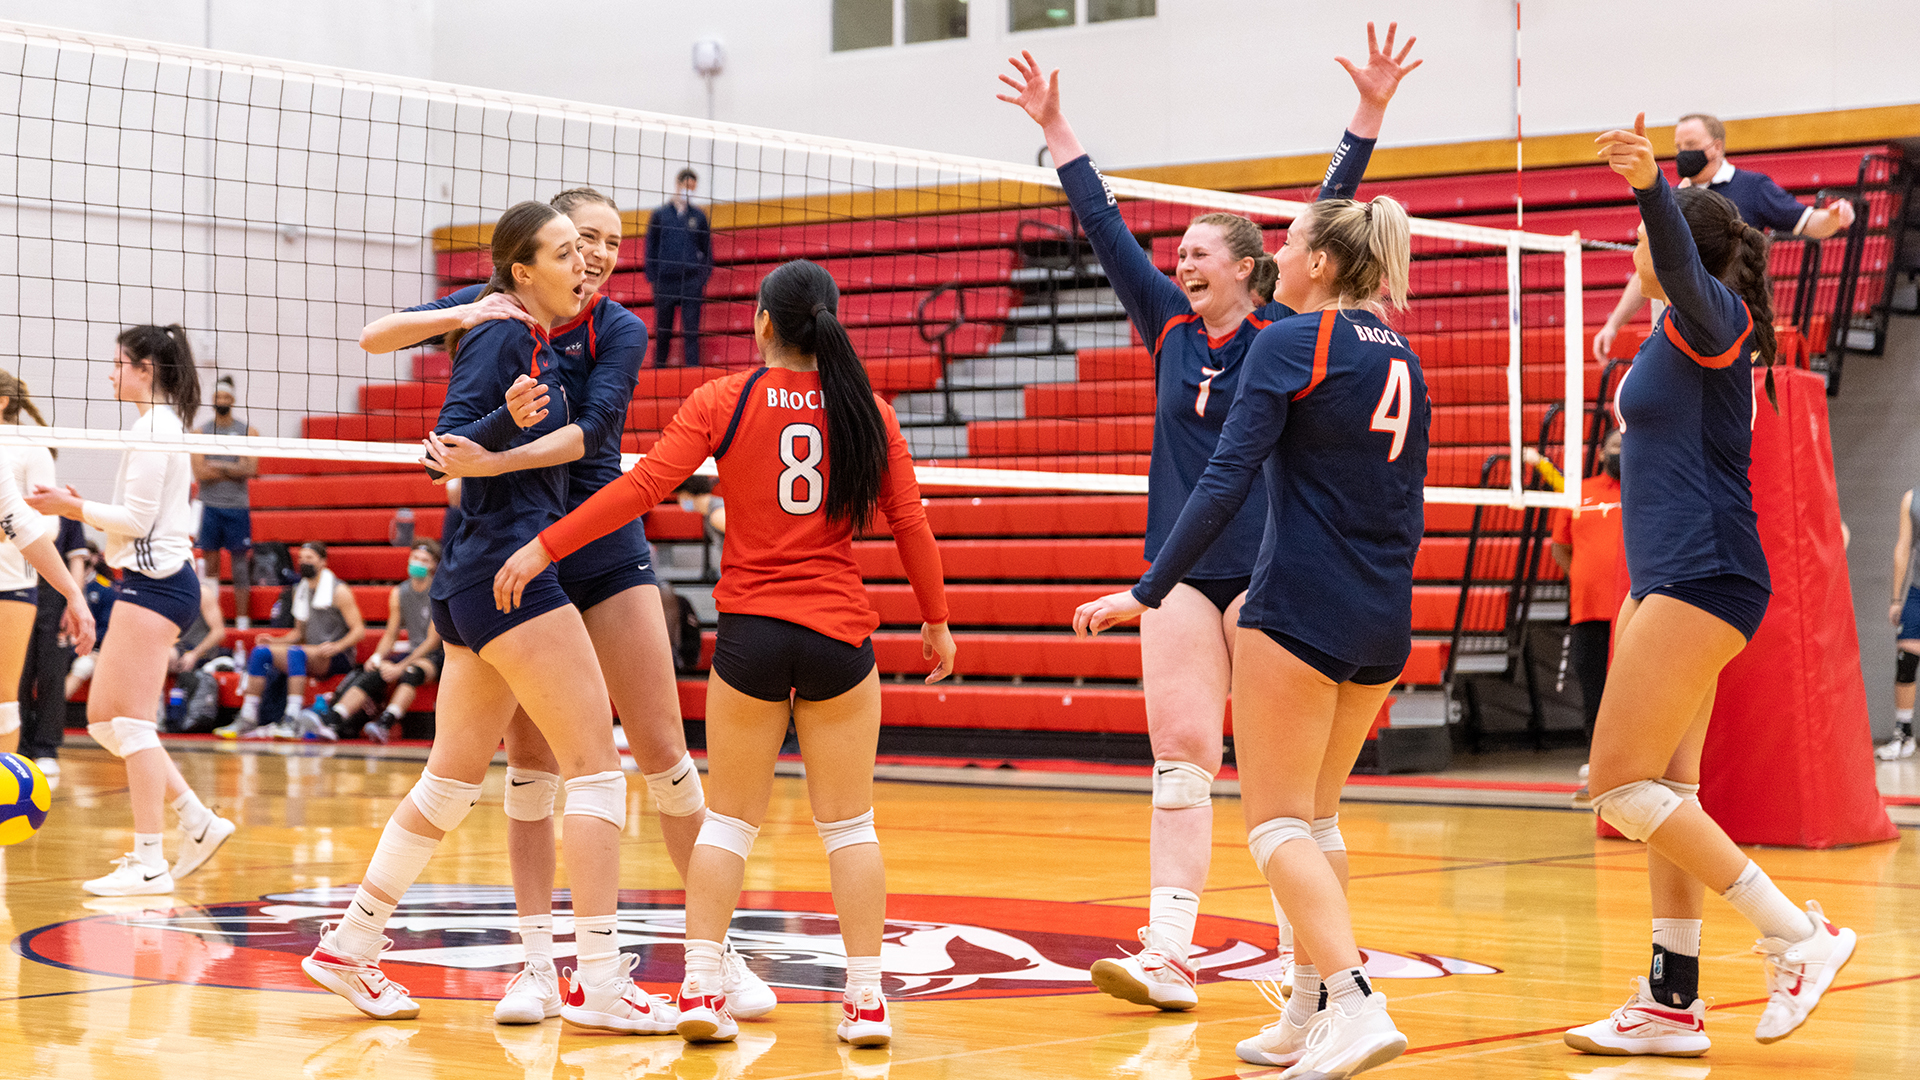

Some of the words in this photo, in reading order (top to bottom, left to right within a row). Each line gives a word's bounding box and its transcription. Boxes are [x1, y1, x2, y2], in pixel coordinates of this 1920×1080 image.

[1322, 141, 1351, 188] SURGITE
[1369, 357, 1412, 463] 4
[777, 422, 824, 516] 8
